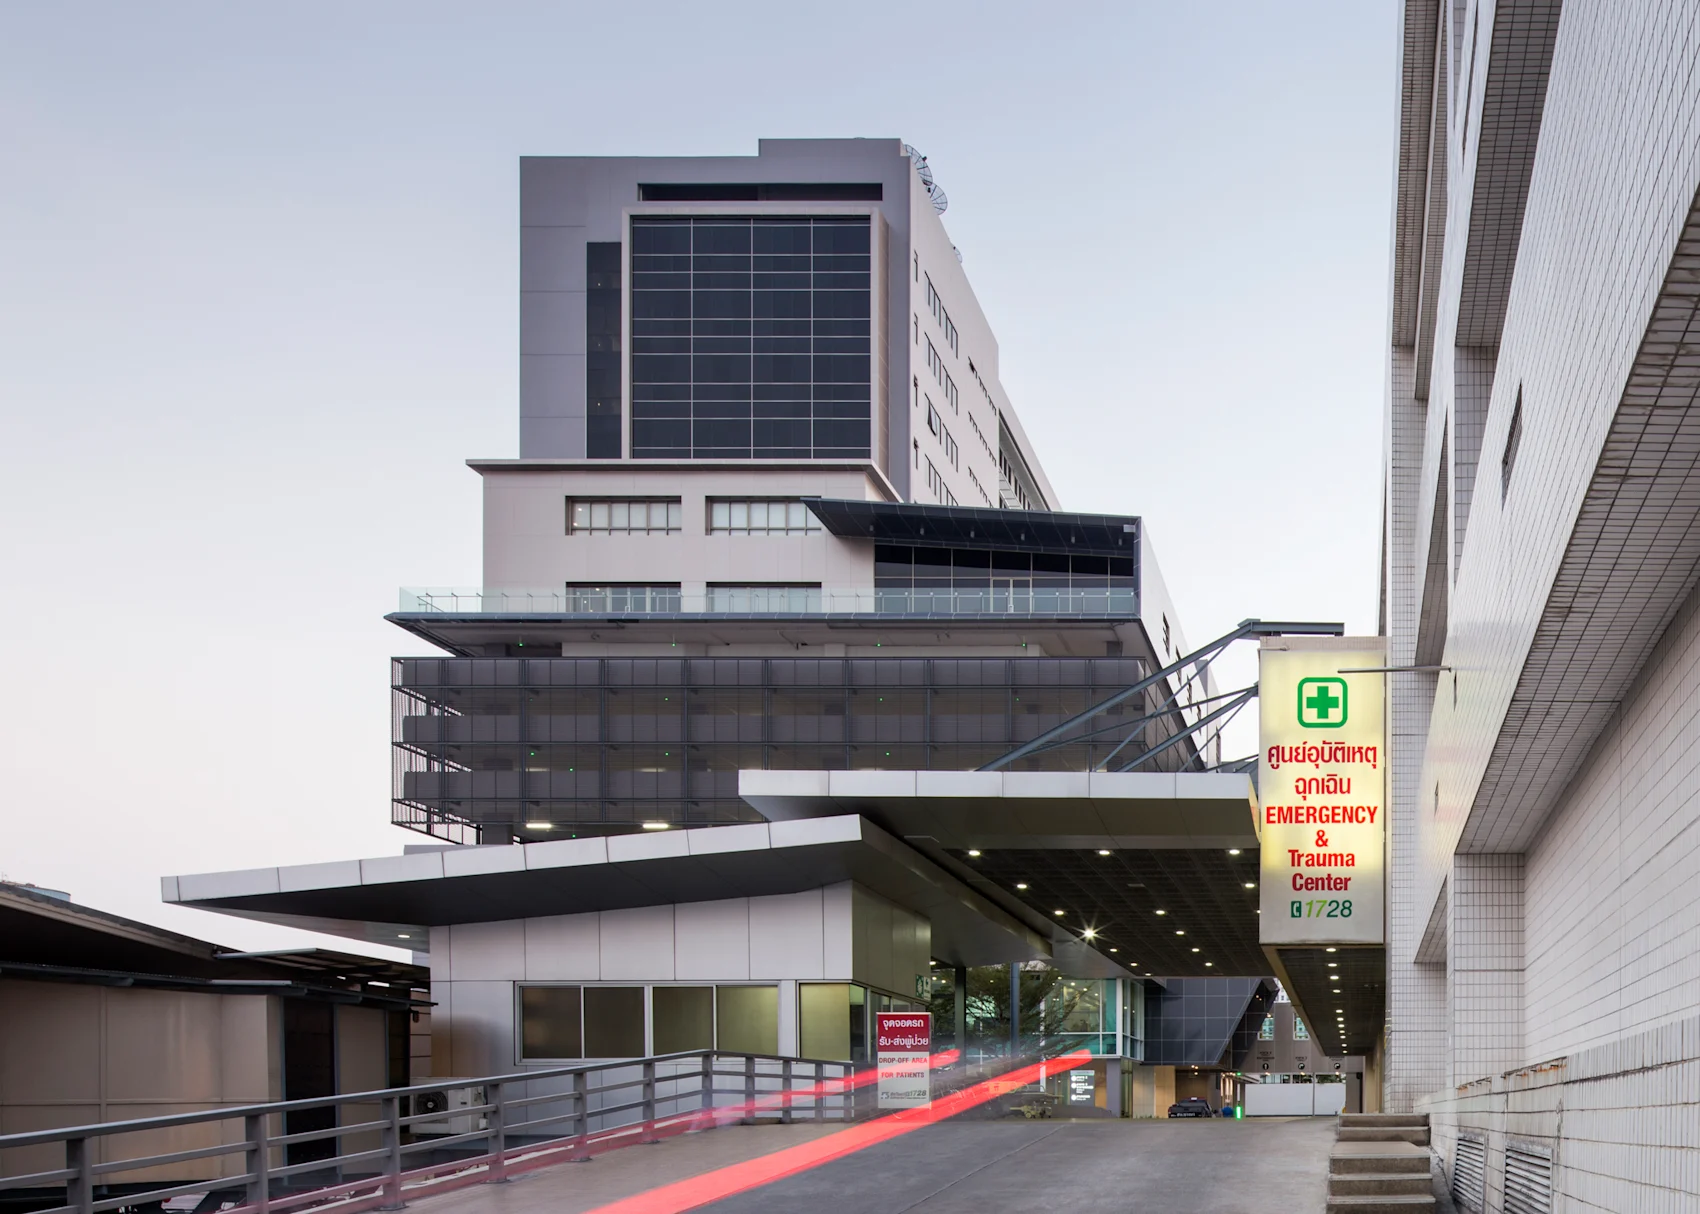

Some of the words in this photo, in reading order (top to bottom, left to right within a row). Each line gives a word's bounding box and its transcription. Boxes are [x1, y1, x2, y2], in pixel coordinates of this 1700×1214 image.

[1267, 741, 1377, 769] ศูนย์อุบัติเหตุ
[1295, 774, 1351, 800] ฉุกเฉิน
[1266, 806, 1378, 824] EMERGENCY
[1315, 830, 1328, 847] &
[1288, 849, 1355, 867] Trauma
[1292, 873, 1351, 891] Center
[1305, 900, 1352, 918] 1728
[882, 1019, 924, 1030] จุดจอดรถ
